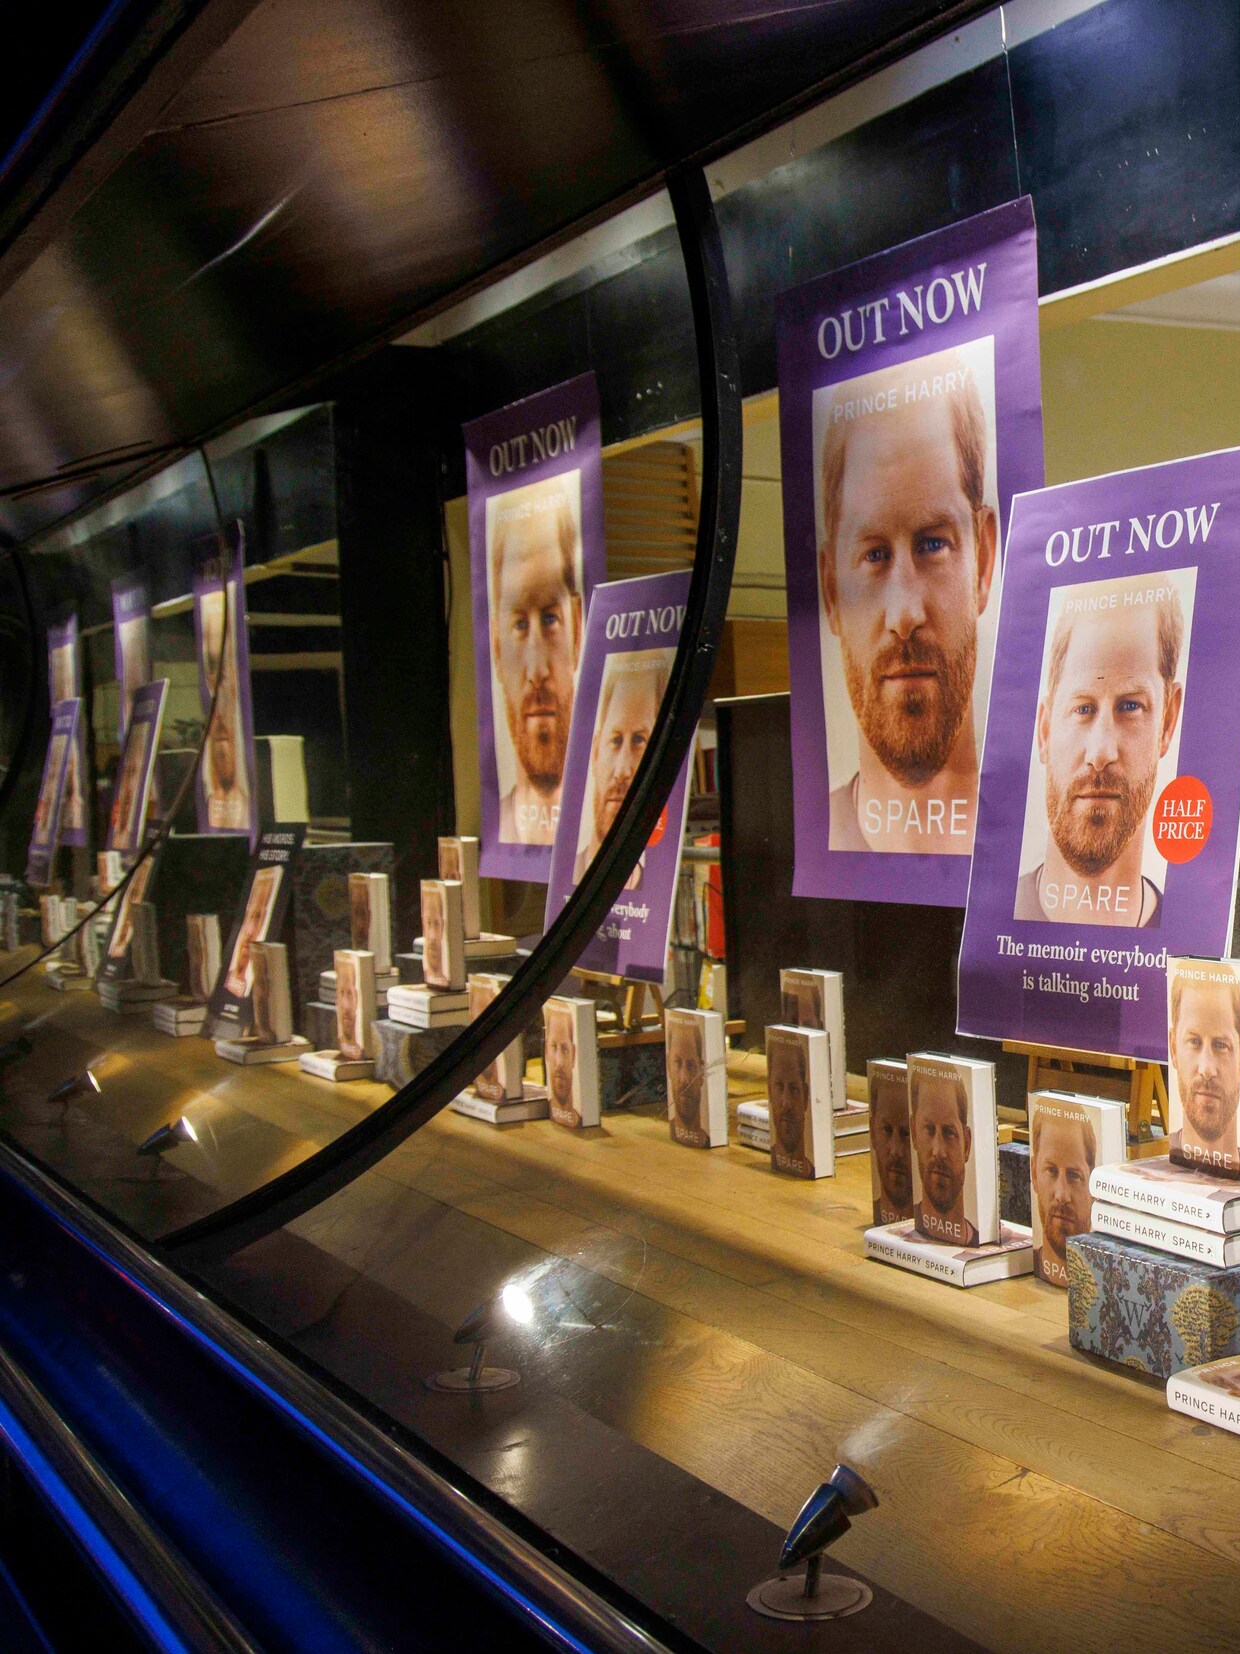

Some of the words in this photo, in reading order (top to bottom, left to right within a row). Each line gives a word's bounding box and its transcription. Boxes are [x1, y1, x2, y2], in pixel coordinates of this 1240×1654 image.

[817, 297, 891, 360] OUT
[899, 262, 987, 336] NOW
[833, 389, 899, 423] PRINCE
[905, 368, 969, 400] HARRY
[489, 435, 528, 477] OUT
[532, 416, 577, 463] NOW
[1045, 521, 1120, 567] OUT
[1125, 502, 1221, 553] NOW
[1064, 595, 1117, 614] PRINCE
[1122, 587, 1176, 606] HARRY
[605, 610, 645, 640] OUT
[518, 804, 561, 831] SPAR
[864, 799, 967, 835] SPARE
[1163, 800, 1206, 820] HALF
[1157, 821, 1205, 841] PRICE
[1043, 883, 1130, 913] SPARE
[610, 902, 650, 923] verybody
[606, 923, 632, 941] about
[996, 935, 1024, 956] The
[1027, 940, 1088, 962] memoir
[1091, 945, 1169, 976] everybod
[1022, 970, 1034, 990] is
[1039, 972, 1089, 1003] talking
[1093, 977, 1139, 1001] about
[1174, 968, 1206, 981] PRINCE
[1209, 973, 1240, 985] HARRY
[912, 1065, 937, 1077] PRINCE
[938, 1070, 962, 1082] HARRY
[1034, 1104, 1063, 1118] PRINCE
[1064, 1109, 1091, 1123] HARRY
[674, 1127, 700, 1145] SPARE
[776, 1154, 804, 1171] SPARE
[1183, 1144, 1233, 1170] SPARE
[1095, 1181, 1130, 1198] PRINCE
[1133, 1190, 1166, 1207] HARRY
[1171, 1201, 1204, 1219] SPARE
[881, 1210, 907, 1224] SPAR
[921, 1215, 962, 1238] SPARE
[1097, 1213, 1131, 1231] PRINCE
[1134, 1224, 1167, 1242] HARRY
[1172, 1236, 1205, 1254] SPARE
[868, 1241, 894, 1257] PRINCE
[896, 1250, 922, 1266] HARRY
[925, 1261, 950, 1276] SPARE
[1043, 1260, 1067, 1279] SPA
[1174, 1391, 1216, 1416] PRINCE
